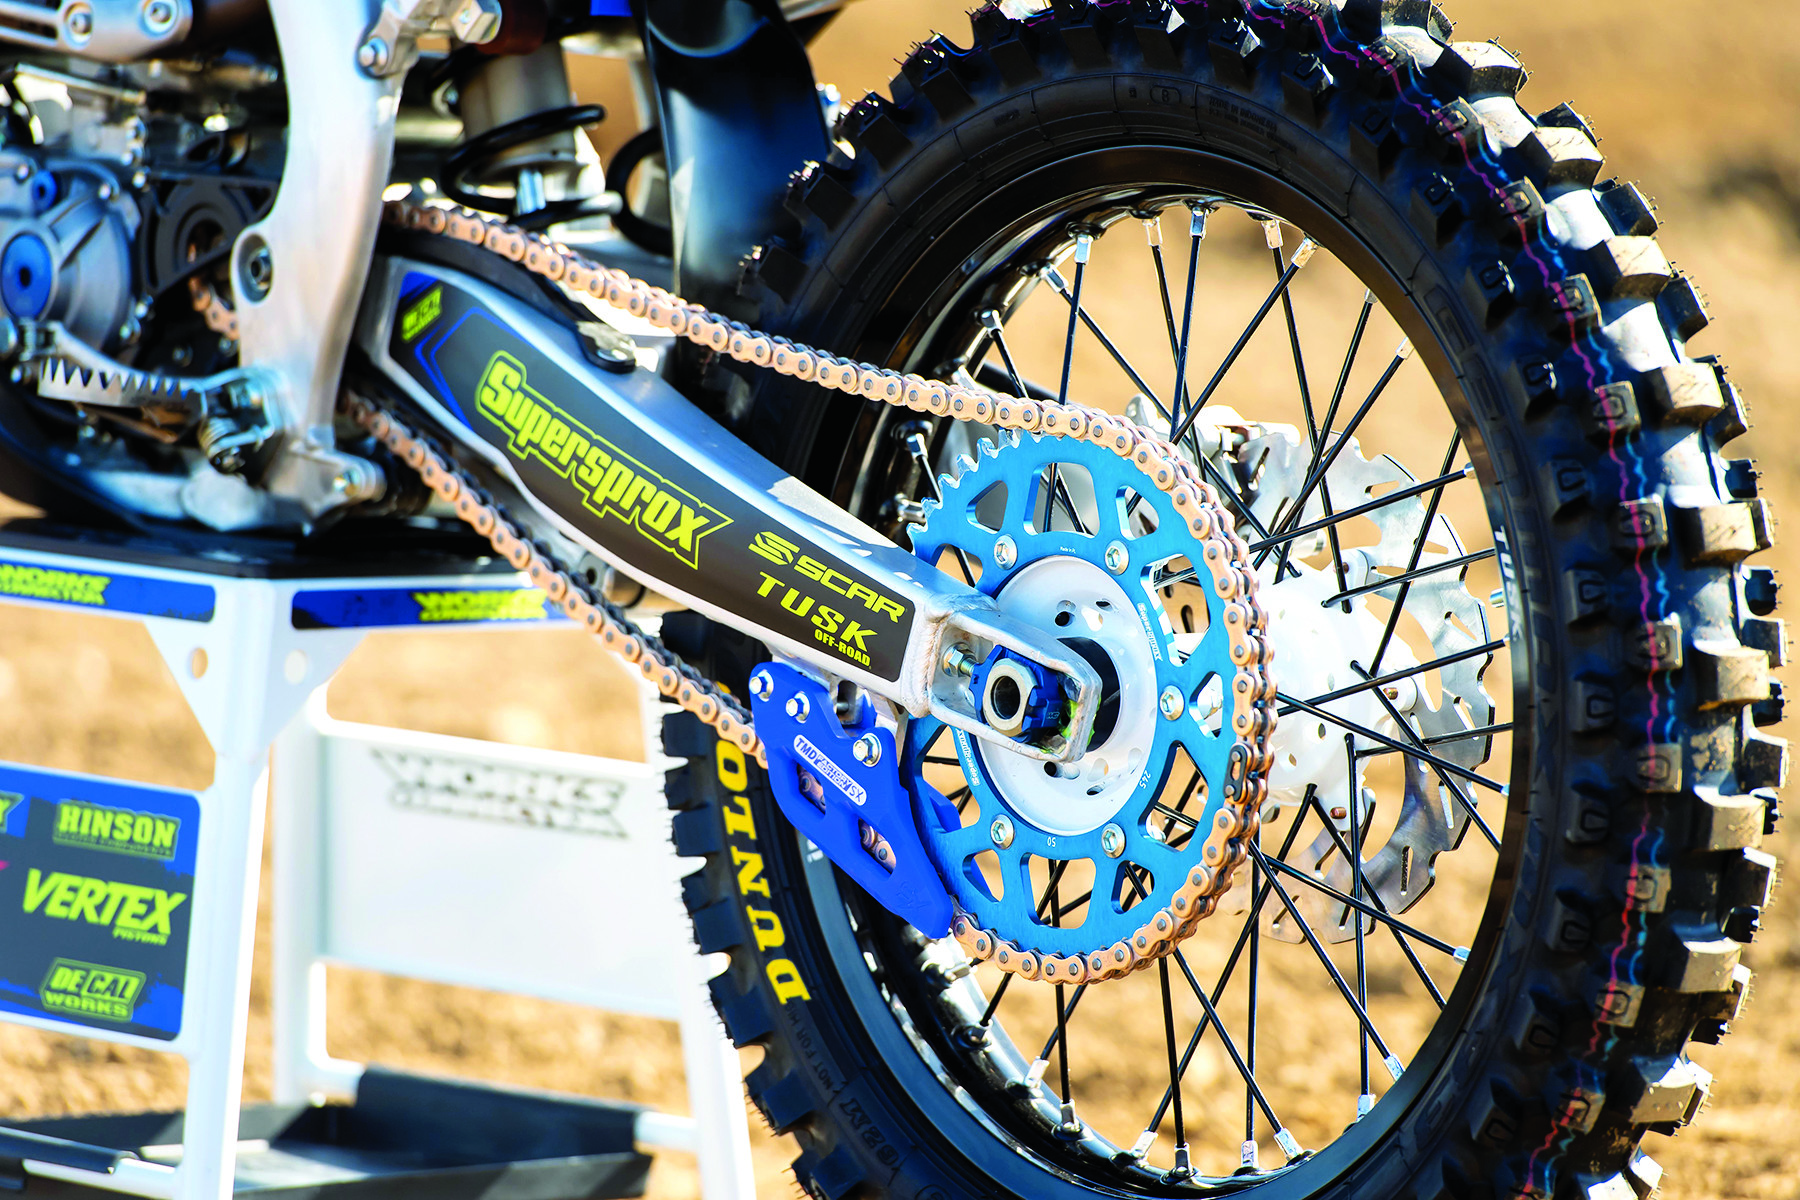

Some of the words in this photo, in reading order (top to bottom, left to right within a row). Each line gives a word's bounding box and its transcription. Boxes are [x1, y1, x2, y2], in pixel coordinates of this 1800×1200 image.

[480, 359, 711, 553] Supersprox
[793, 554, 906, 624] SCAR
[1493, 524, 1525, 643] TUSK
[756, 571, 878, 652] TUSK
[813, 628, 871, 667] OFF-ROAD
[795, 737, 818, 760] TMD
[815, 762, 846, 791] EDITION
[817, 753, 853, 787] FACTORY
[1138, 769, 1152, 790] 245
[848, 784, 864, 803] SX
[57, 803, 177, 848] HINSON
[714, 682, 812, 1006] DUNLO
[1046, 836, 1057, 848] 50
[22, 867, 188, 936] VERTEX
[49, 965, 142, 1000] DECAL
[44, 991, 129, 1017] WORKS
